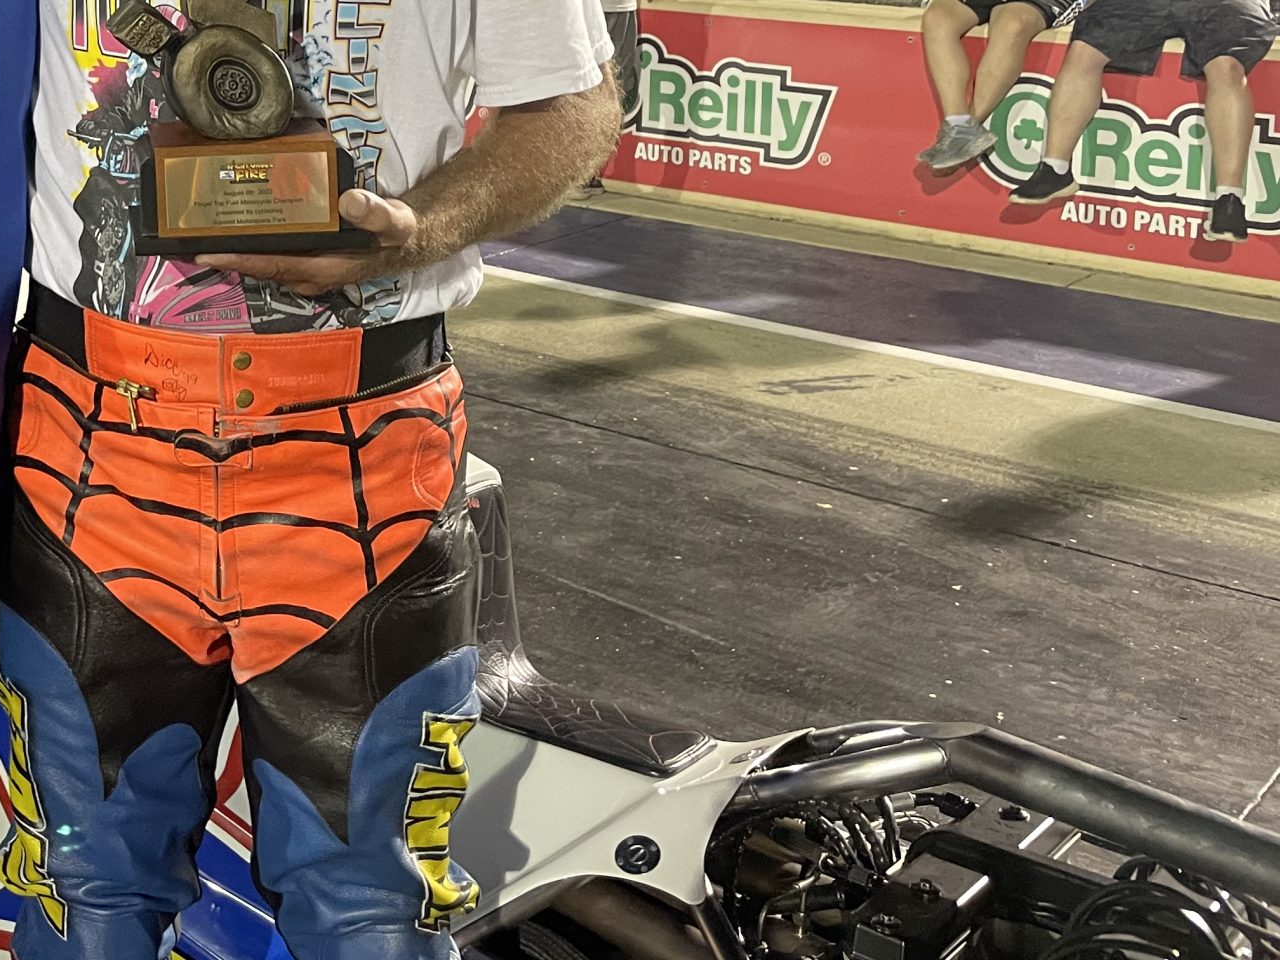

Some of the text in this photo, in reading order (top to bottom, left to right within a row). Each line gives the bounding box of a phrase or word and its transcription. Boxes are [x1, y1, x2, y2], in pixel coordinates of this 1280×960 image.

[634, 142, 753, 176] AUTO PARTS
[235, 169, 269, 182] FIRE
[1060, 201, 1128, 229] AUTO
